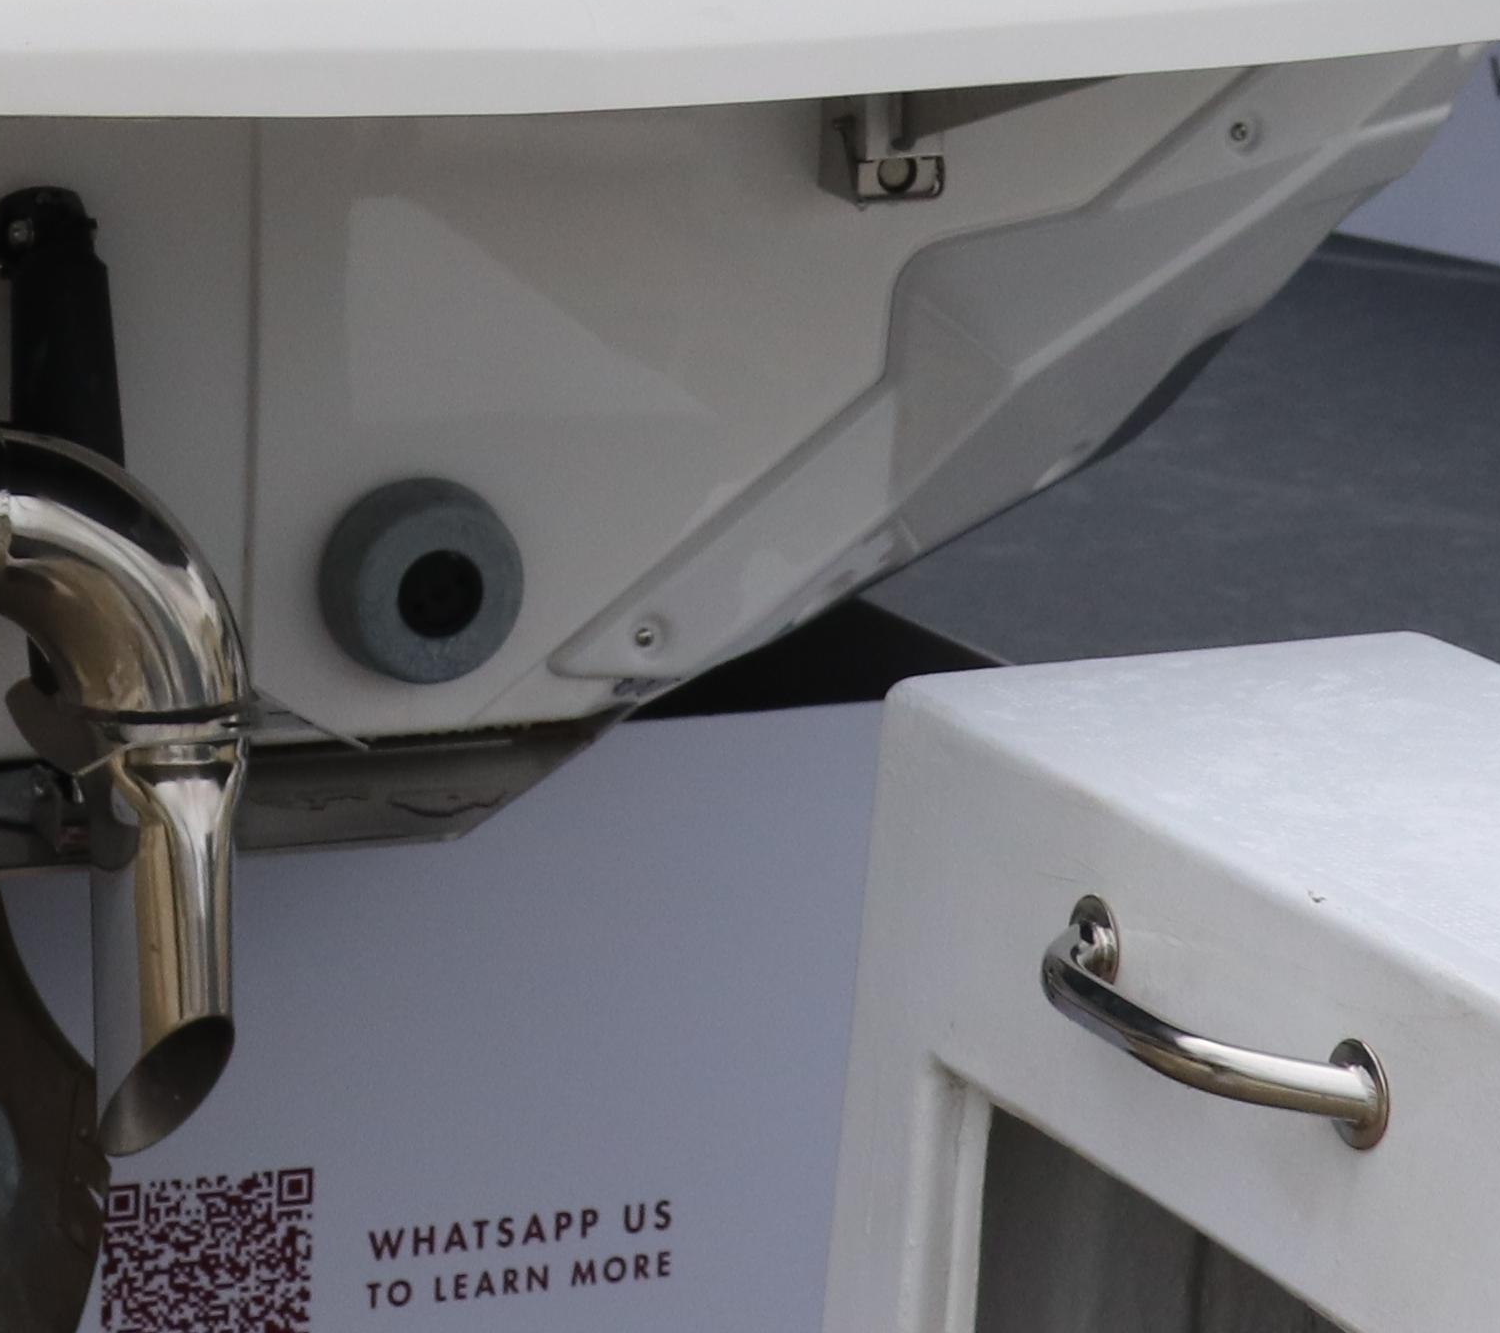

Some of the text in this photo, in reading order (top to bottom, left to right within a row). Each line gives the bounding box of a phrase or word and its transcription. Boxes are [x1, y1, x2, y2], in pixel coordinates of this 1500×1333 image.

[368, 1199, 674, 1263] WHATSAPP US
[366, 1250, 673, 1310] TO LEARN MORE
